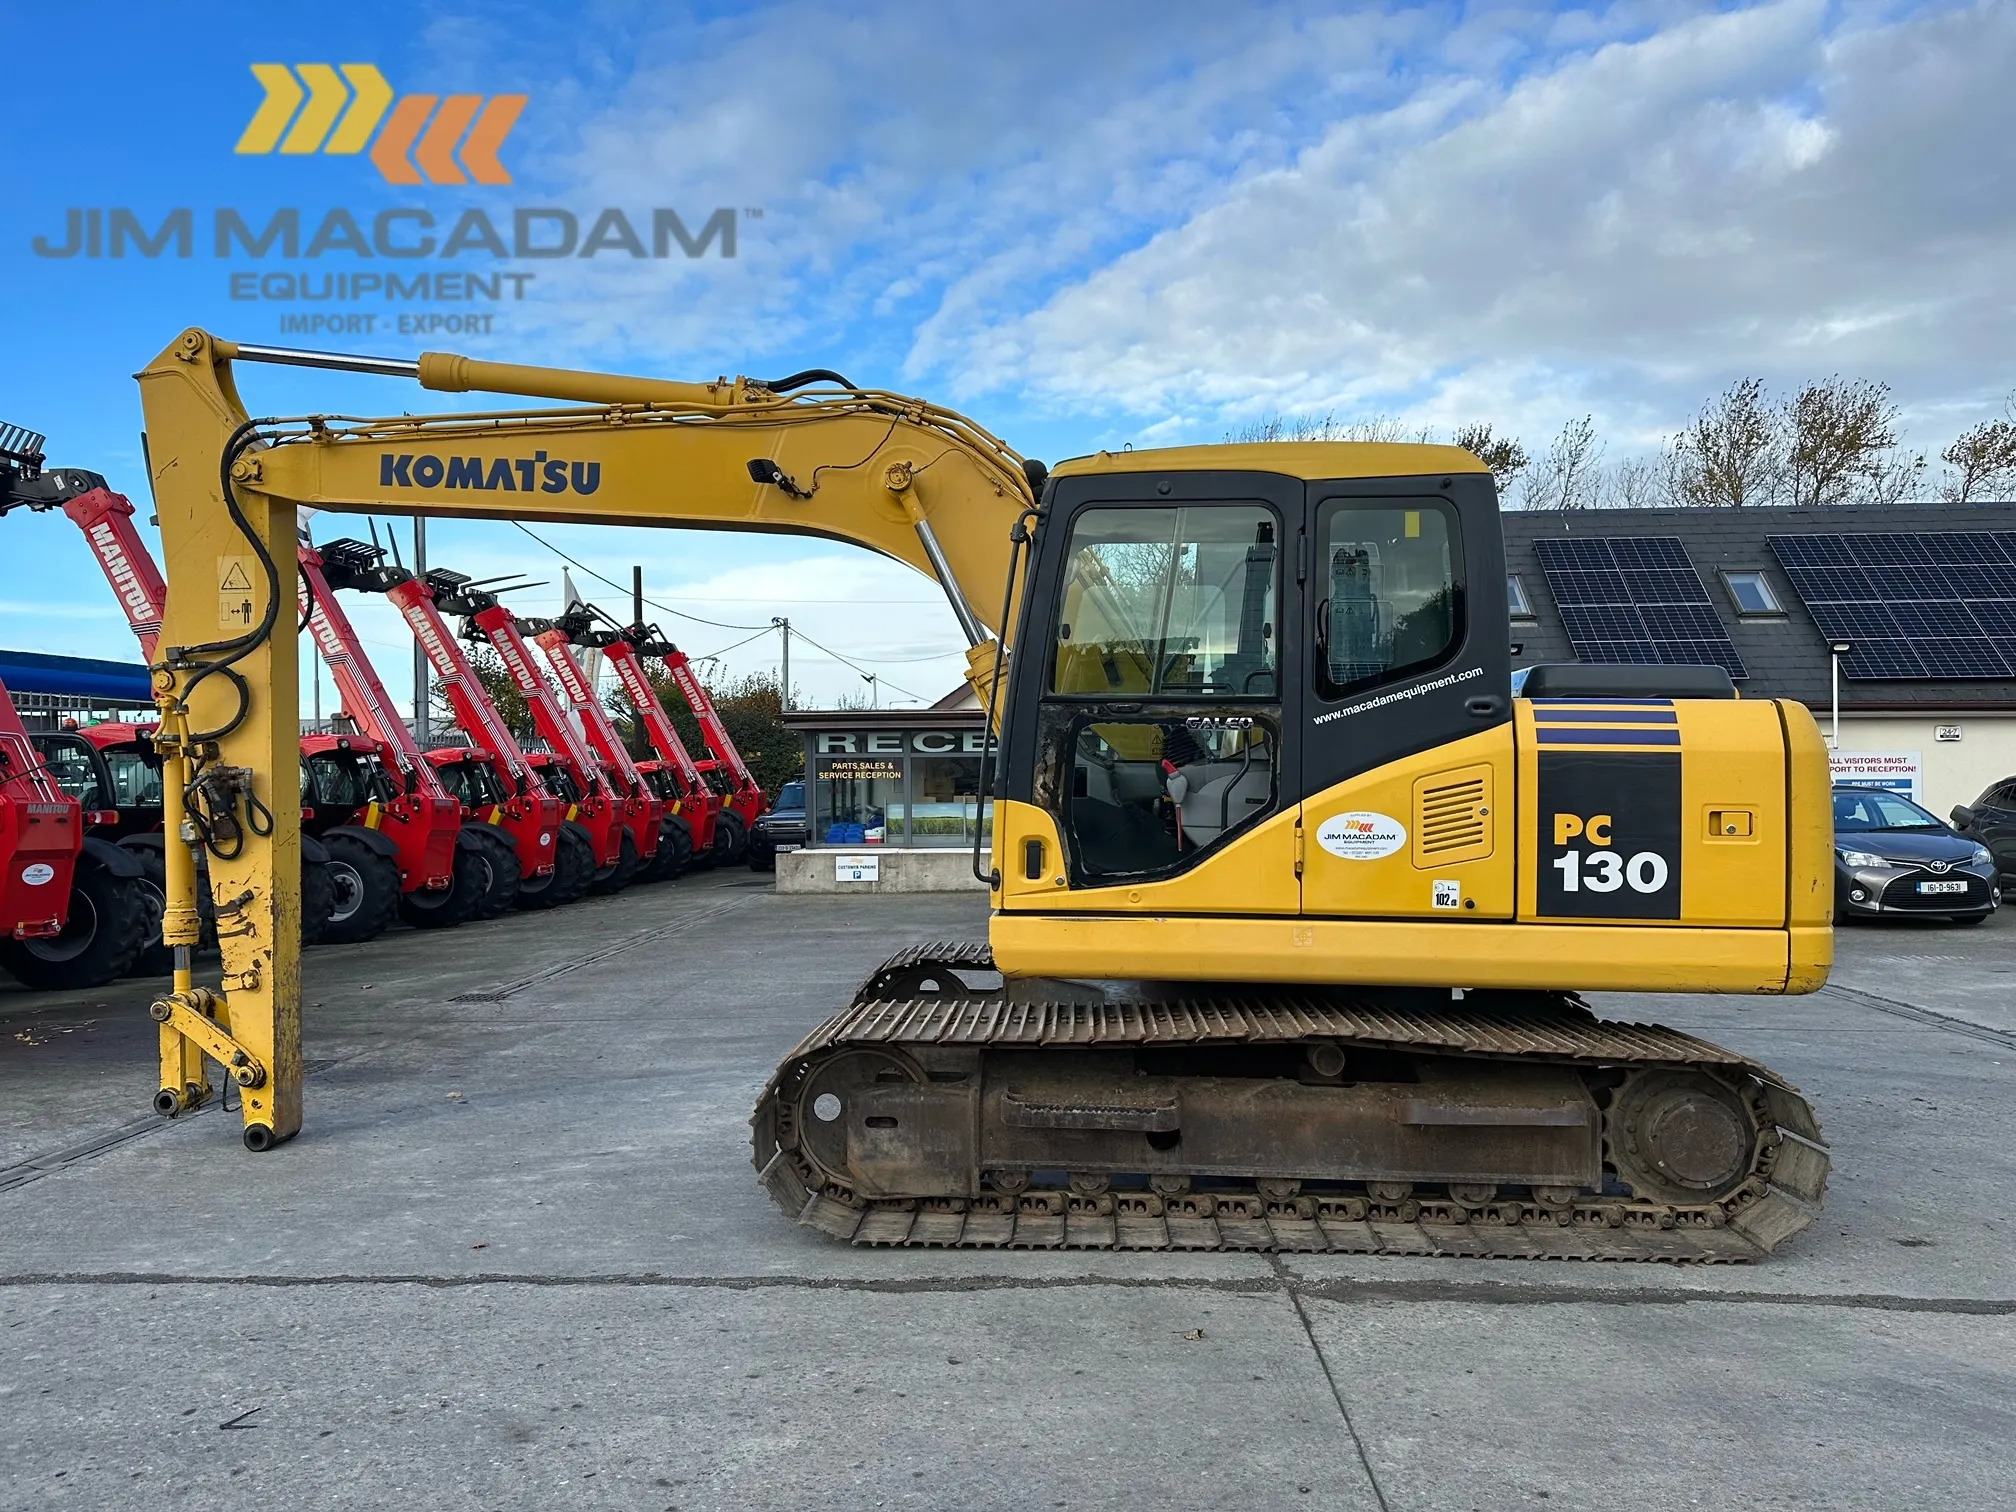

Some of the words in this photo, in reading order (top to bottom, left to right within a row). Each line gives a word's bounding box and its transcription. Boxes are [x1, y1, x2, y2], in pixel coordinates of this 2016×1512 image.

[380, 450, 600, 495] KOMATSU
[89, 521, 155, 620] MANITOU
[406, 605, 458, 675] MANITOU
[491, 628, 537, 689] MANITOU
[548, 647, 587, 702] MANITOU
[616, 658, 650, 707] MANITOU
[673, 666, 705, 711] MANITOU
[1313, 666, 1484, 725] www.macadamequipment.com
[1185, 717, 1254, 730] GALEO
[818, 772, 853, 780] SERVICE
[855, 771, 901, 779] RECEPTION
[887, 762, 894, 770] &
[1867, 765, 1917, 773] RECEPTION!
[27, 804, 70, 814] MANITOU
[1554, 813, 1612, 846] PC
[1553, 850, 1669, 894] 130
[1435, 893, 1450, 906] 102
